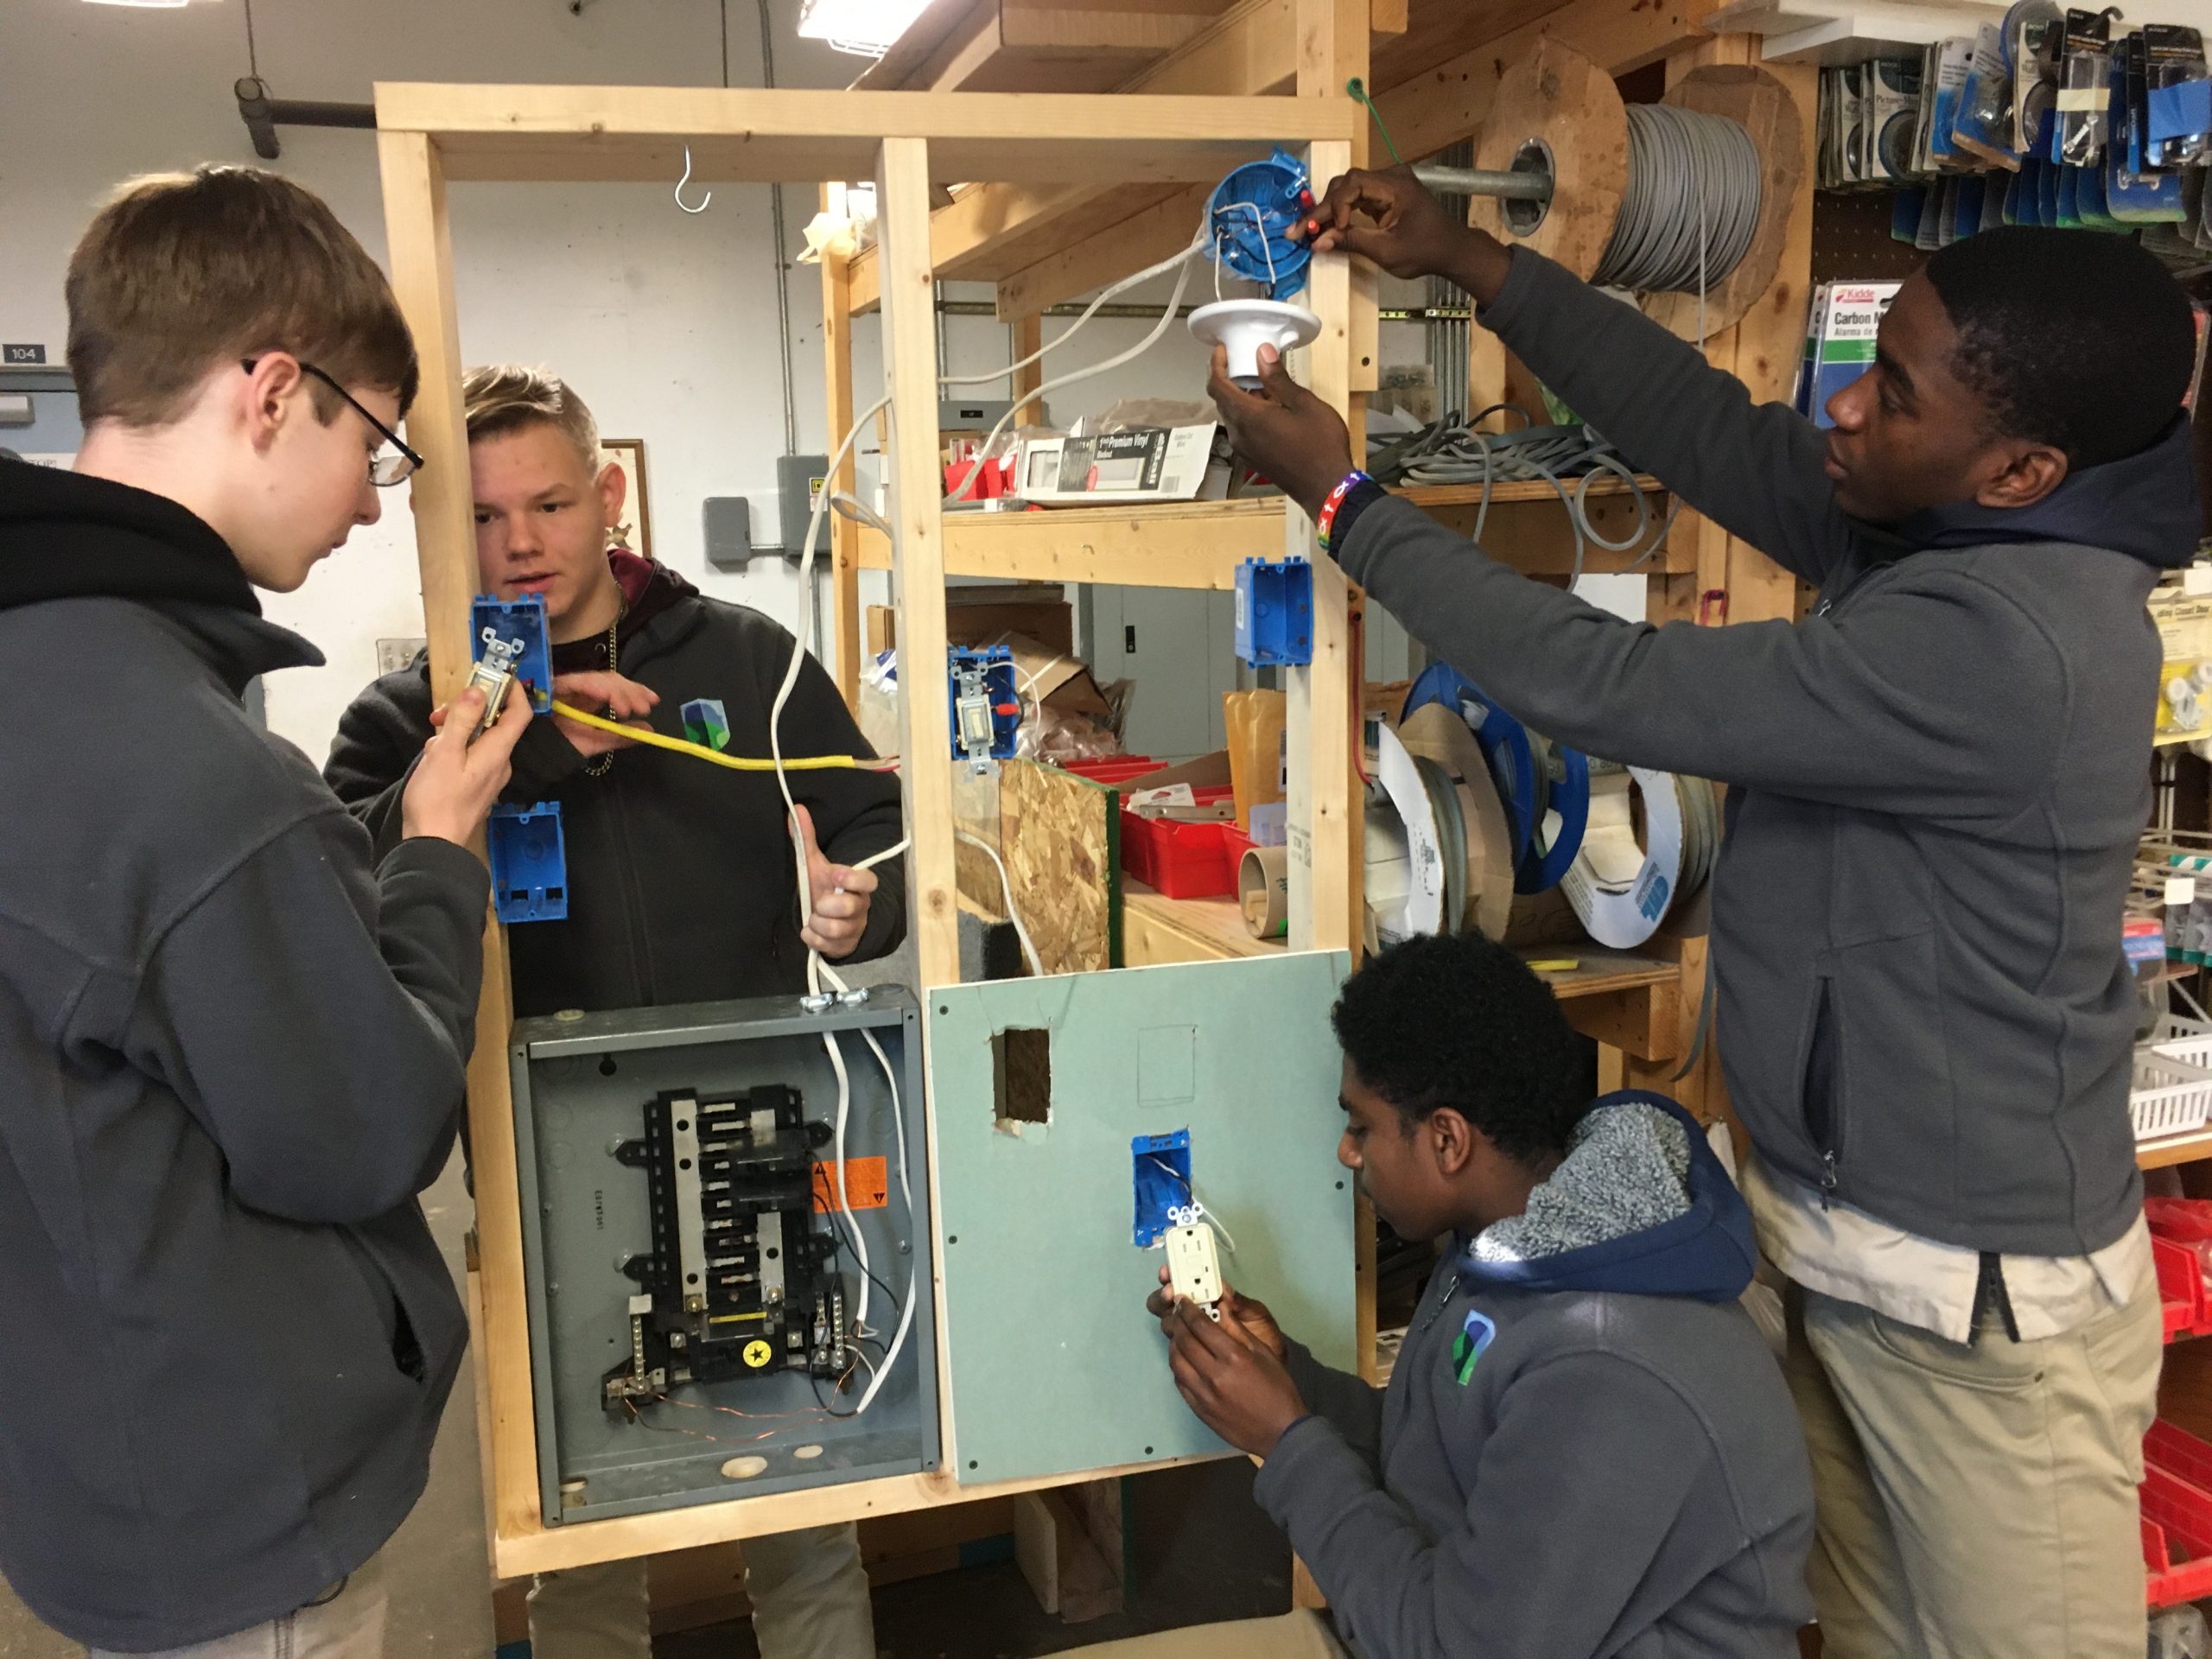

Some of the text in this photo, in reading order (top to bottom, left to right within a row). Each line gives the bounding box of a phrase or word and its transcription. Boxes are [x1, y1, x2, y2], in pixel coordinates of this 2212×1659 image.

[1847, 289, 1874, 298] Kidde
[1834, 312, 1871, 325] Carbon
[1834, 327, 1861, 336] Alarma
[12, 348, 36, 359] 104
[1109, 435, 1134, 448] Premium
[1135, 433, 1150, 448] Vinyl
